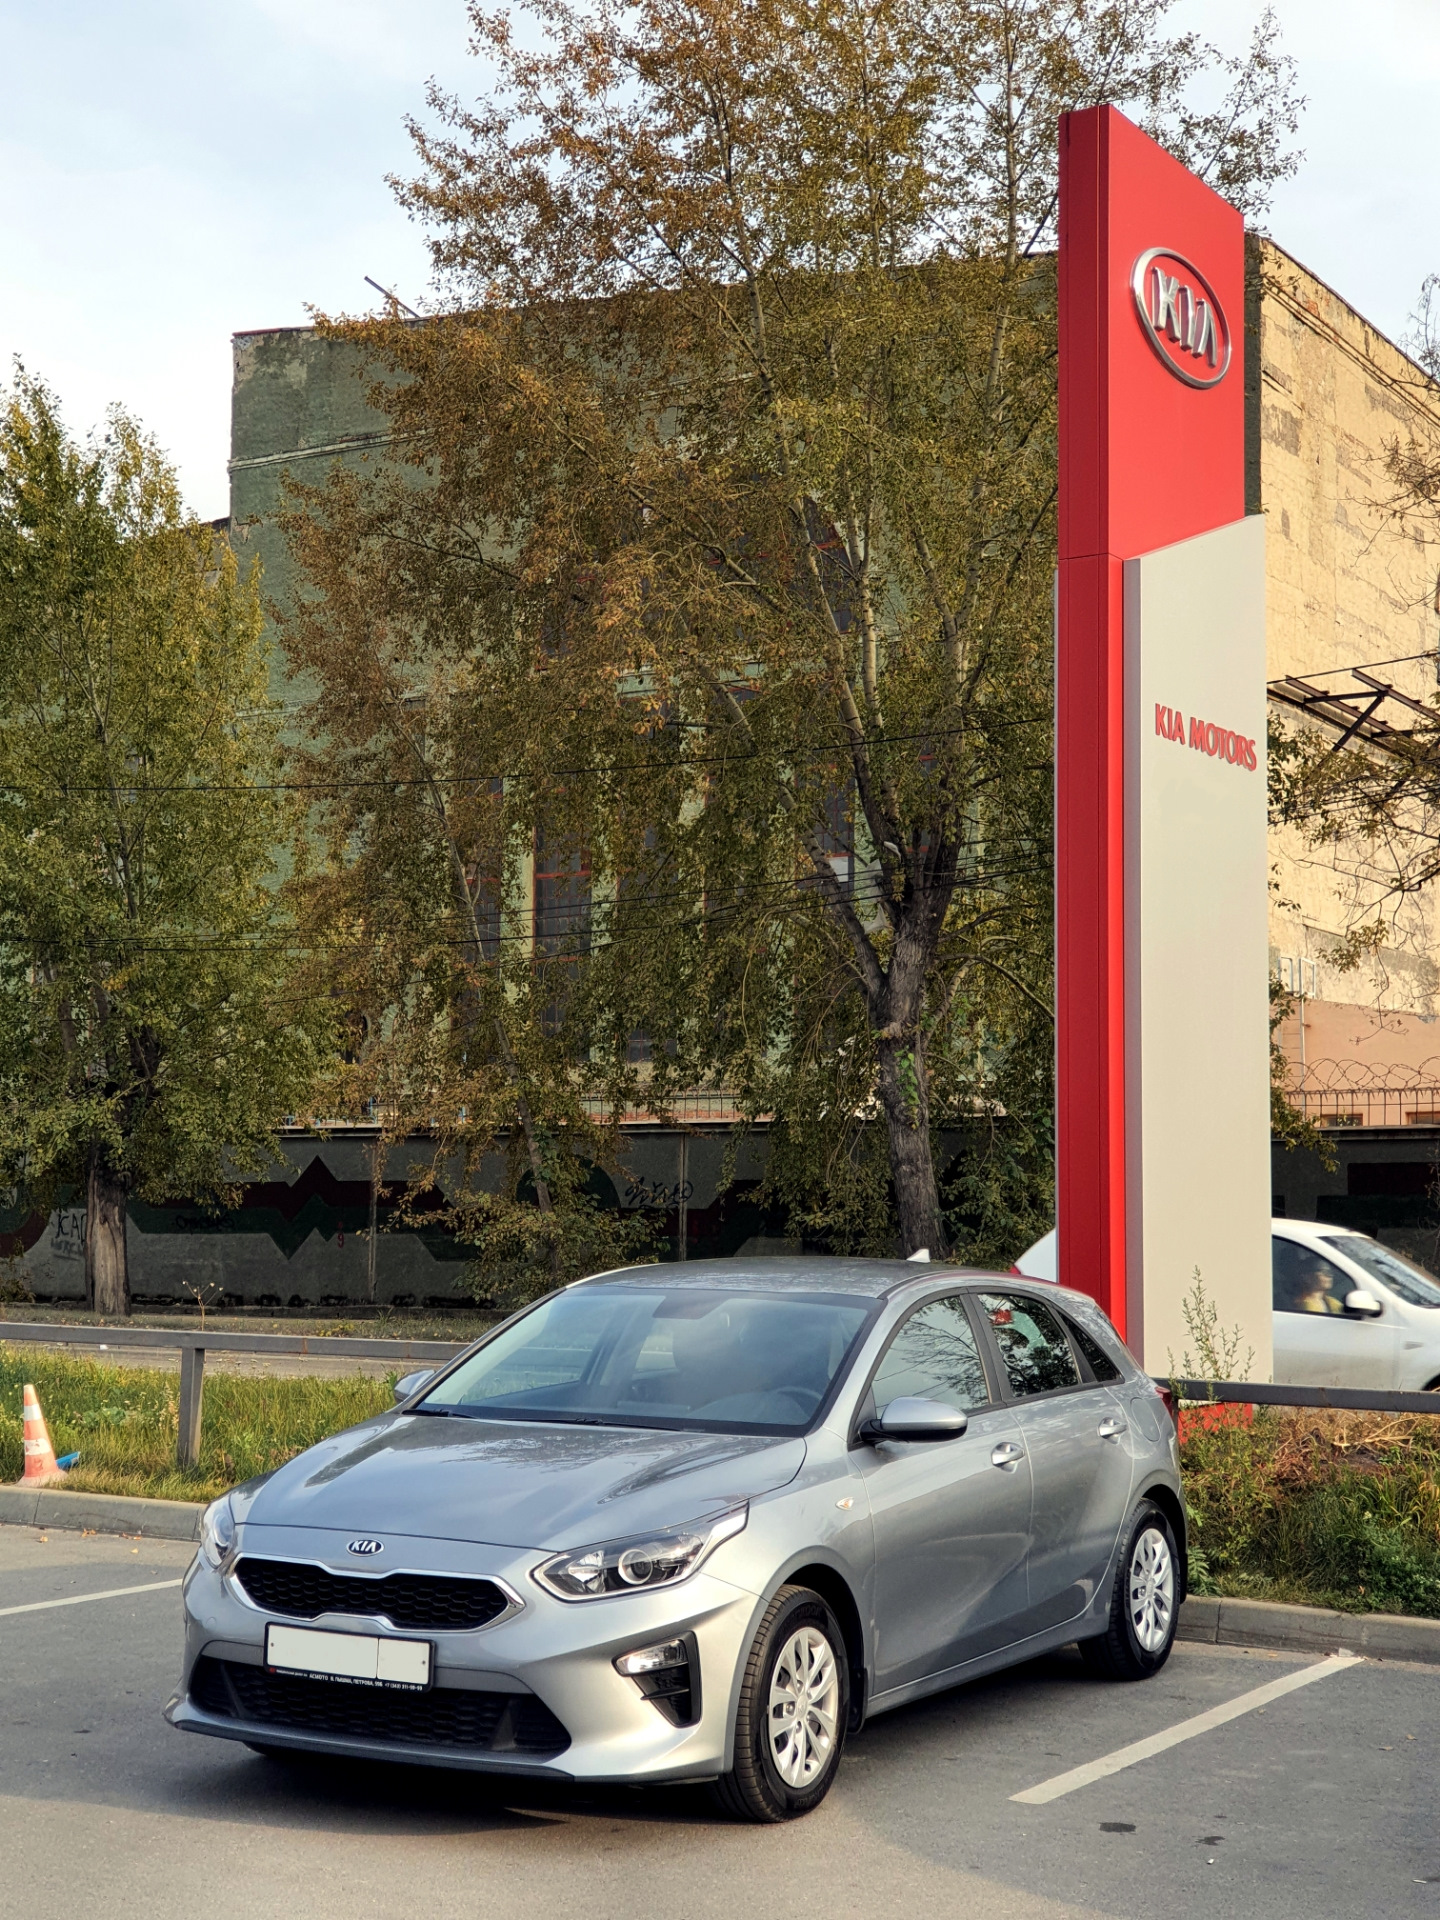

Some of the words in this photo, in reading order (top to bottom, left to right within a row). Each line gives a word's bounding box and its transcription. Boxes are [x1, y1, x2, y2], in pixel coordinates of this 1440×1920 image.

[1151, 266, 1218, 369] KIA
[1155, 703, 1186, 745] KIA
[1189, 716, 1257, 772] MOTORS
